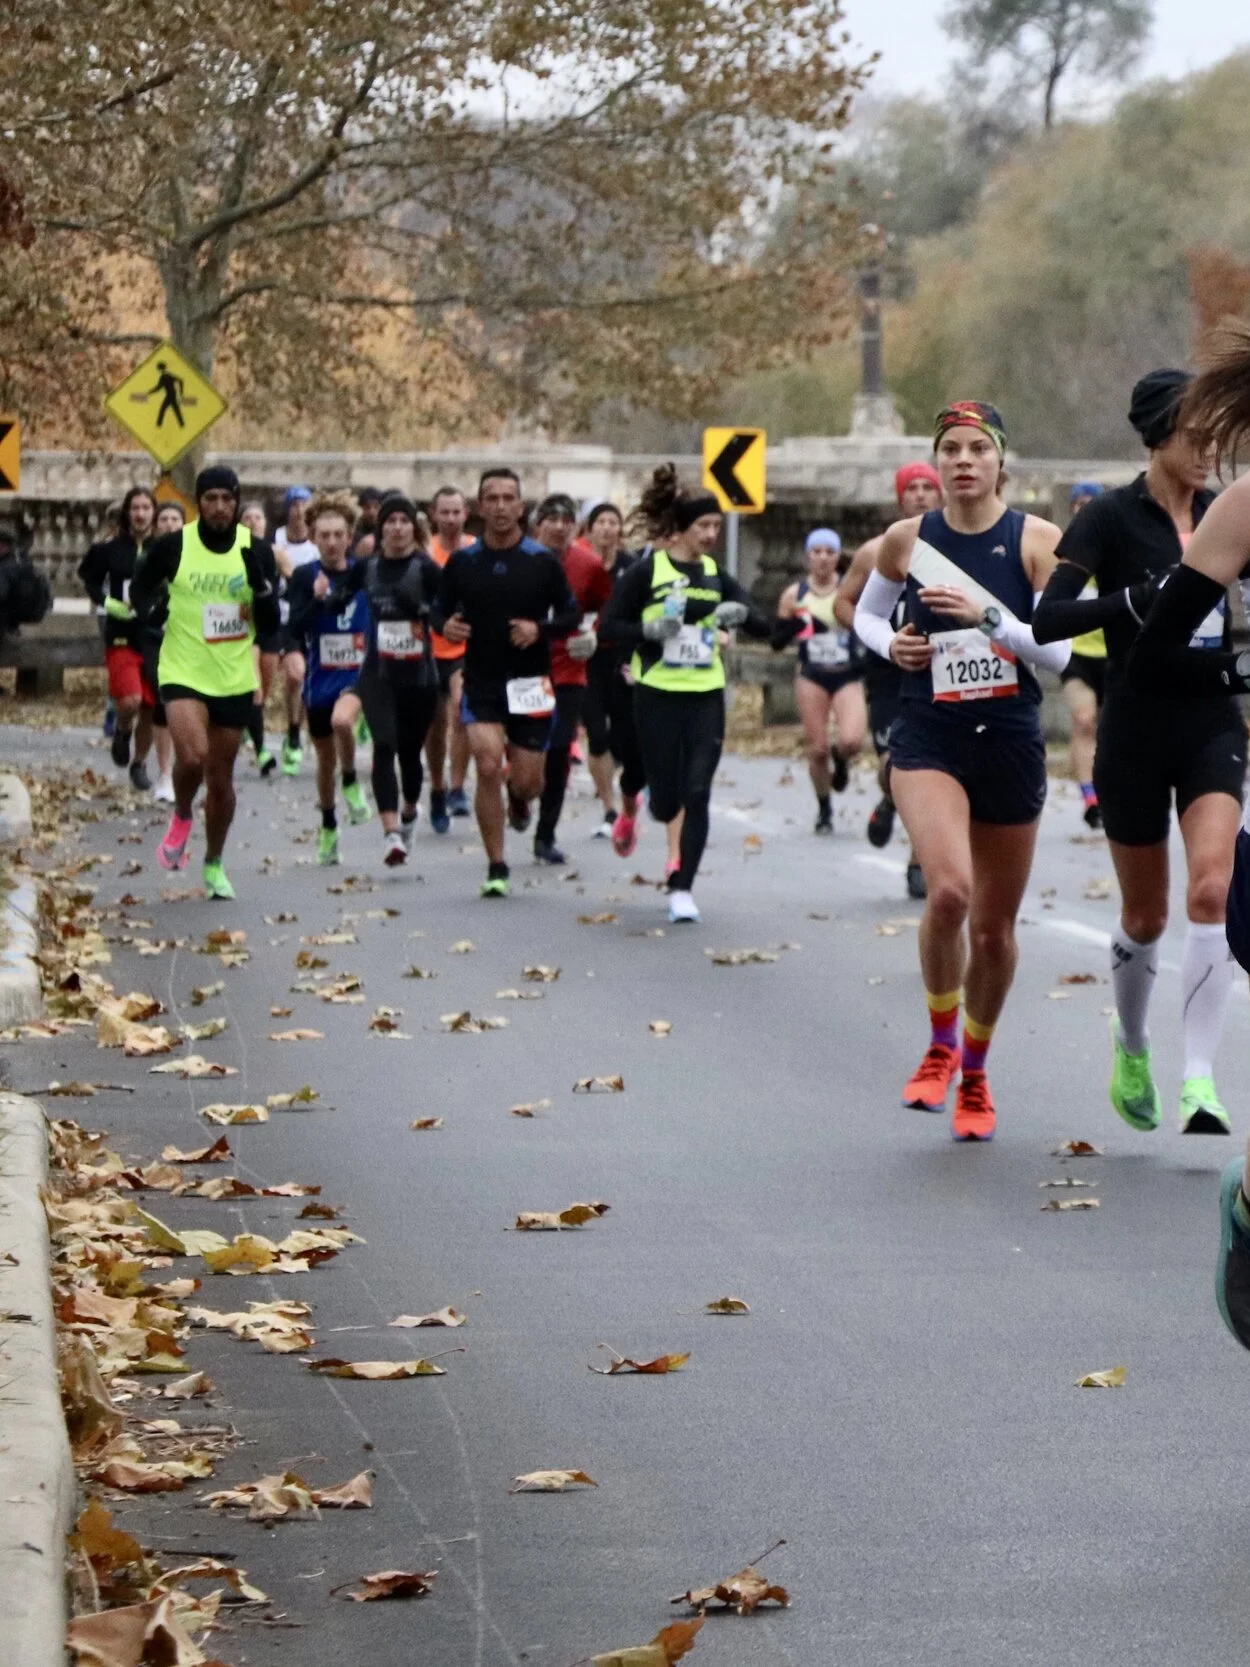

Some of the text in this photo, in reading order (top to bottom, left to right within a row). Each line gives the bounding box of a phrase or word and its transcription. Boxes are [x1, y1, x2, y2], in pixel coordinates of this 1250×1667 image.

[189, 572, 228, 584] FLEET
[193, 583, 224, 593] FEET
[946, 657, 1003, 685] 12032
